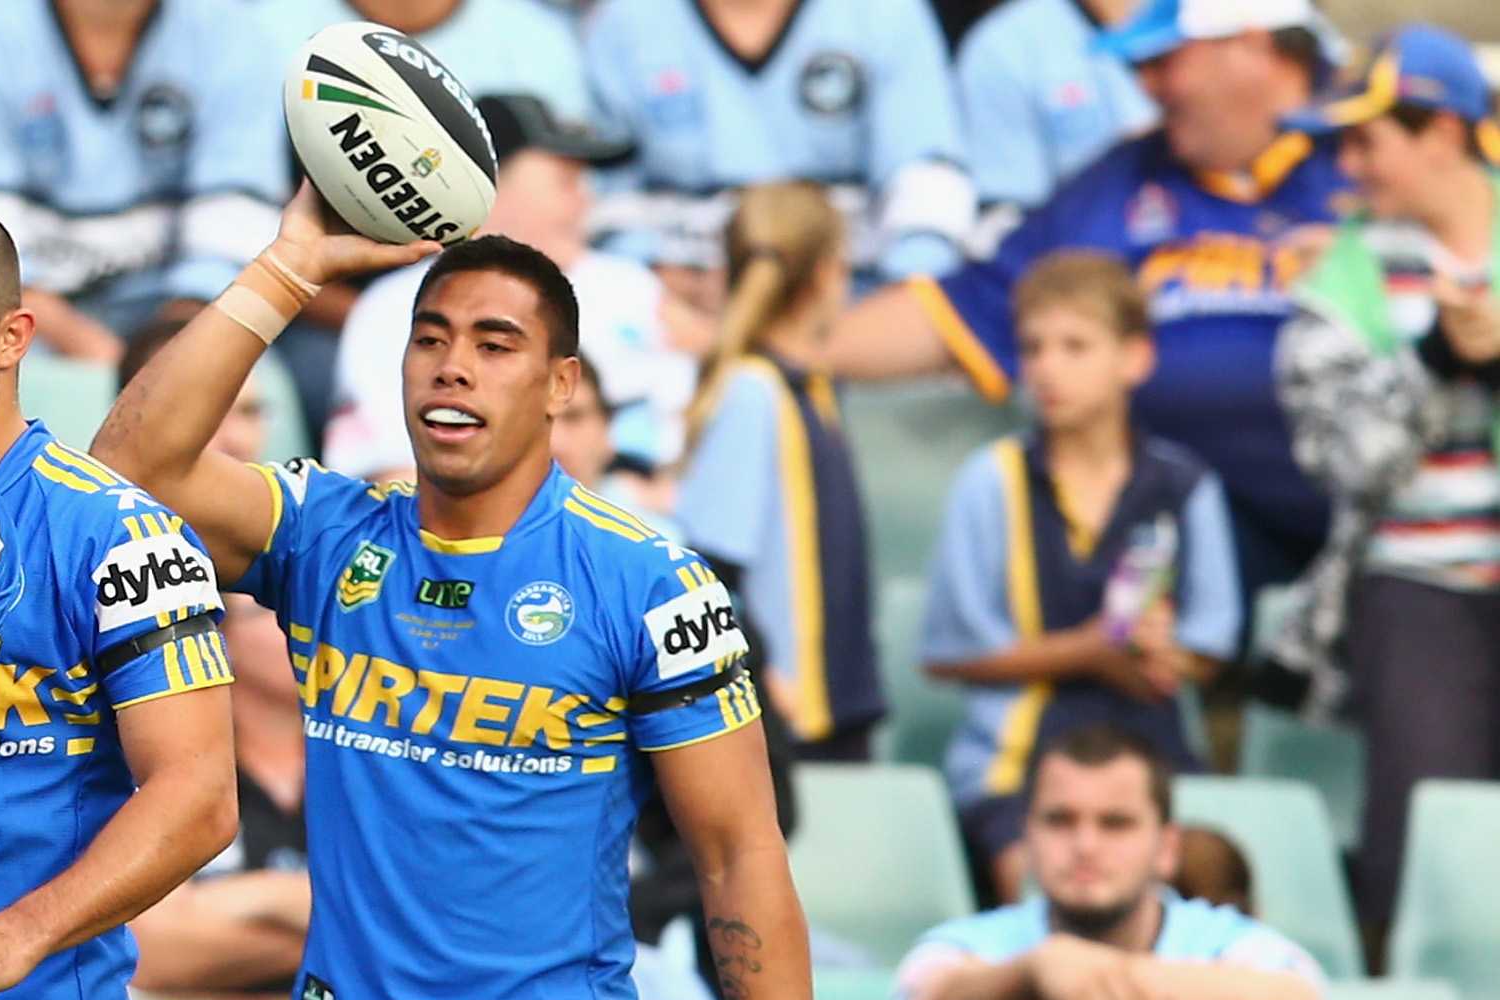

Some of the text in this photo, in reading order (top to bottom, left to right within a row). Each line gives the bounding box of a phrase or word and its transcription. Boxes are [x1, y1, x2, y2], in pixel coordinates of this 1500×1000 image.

[329, 112, 467, 245] STEEDEN
[97, 548, 209, 607] dylda
[303, 643, 592, 750] PIRTEK
[441, 750, 573, 775] solutions
